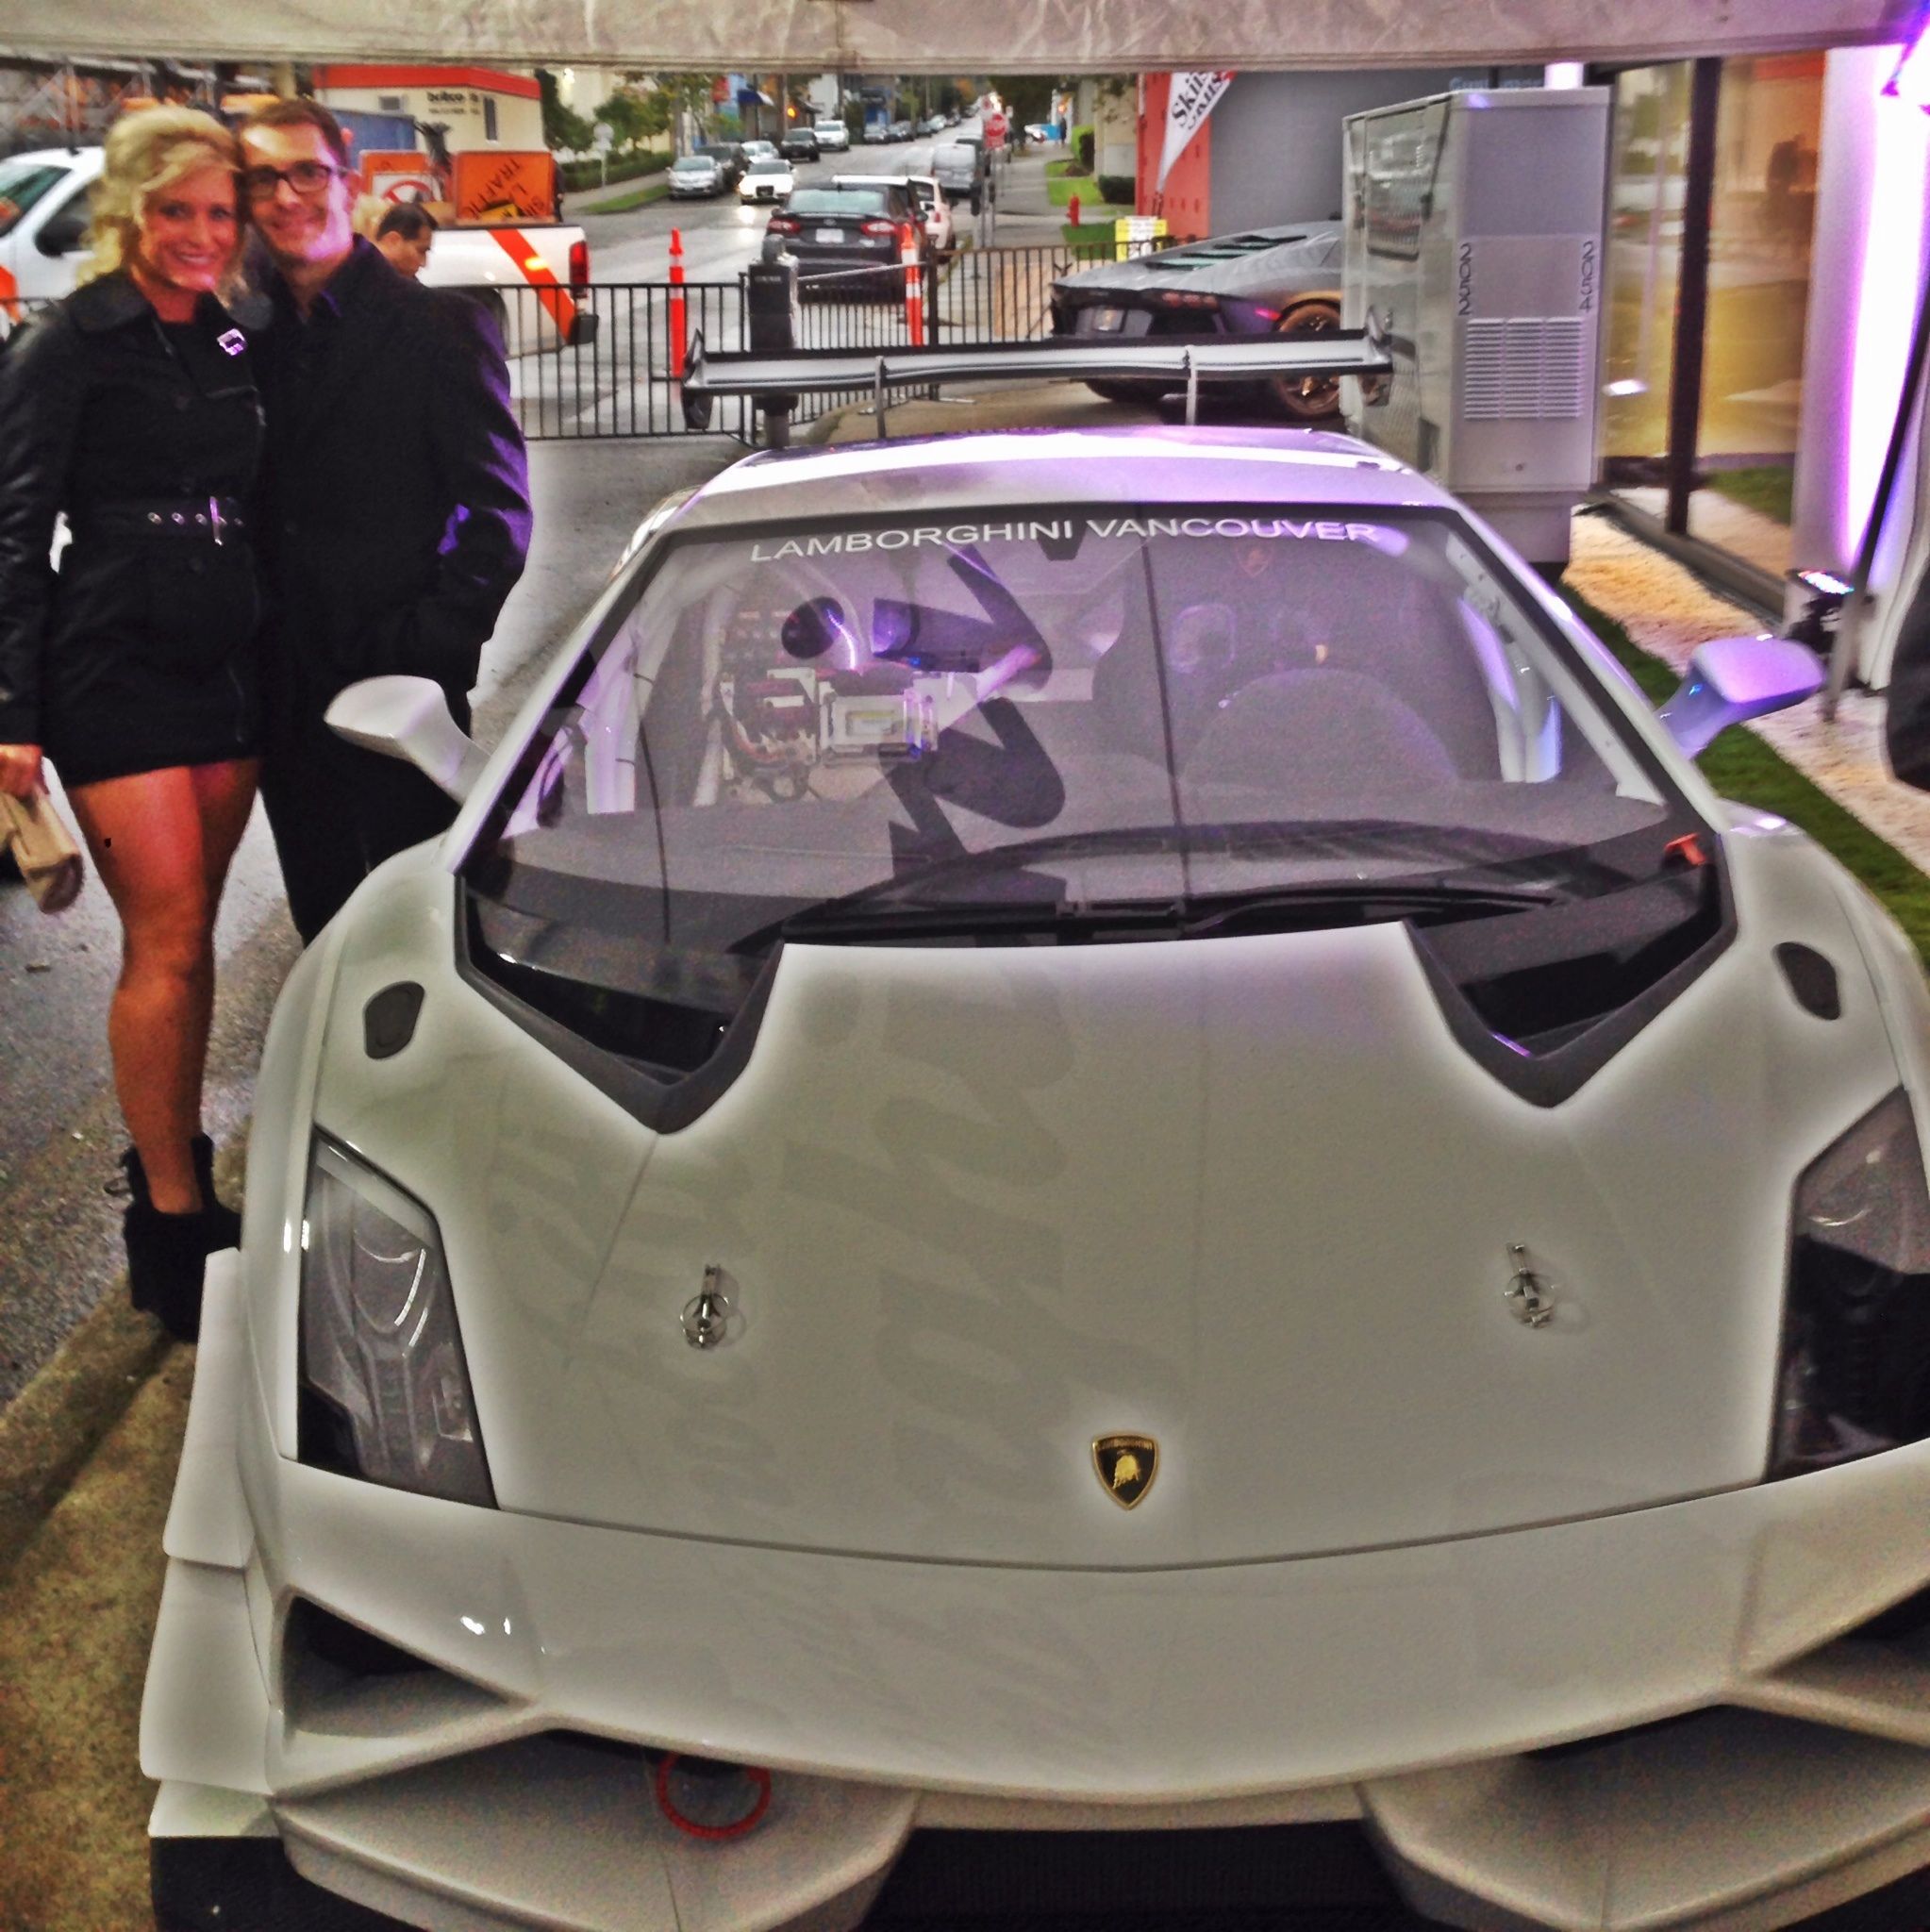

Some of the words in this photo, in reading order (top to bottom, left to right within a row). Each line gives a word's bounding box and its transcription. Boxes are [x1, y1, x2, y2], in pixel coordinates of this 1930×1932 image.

[1458, 242, 1472, 316] 2052
[1579, 240, 1595, 313] 2054
[750, 520, 1073, 562] LAMBORGHINI
[1087, 518, 1378, 541] VANCOUVER
